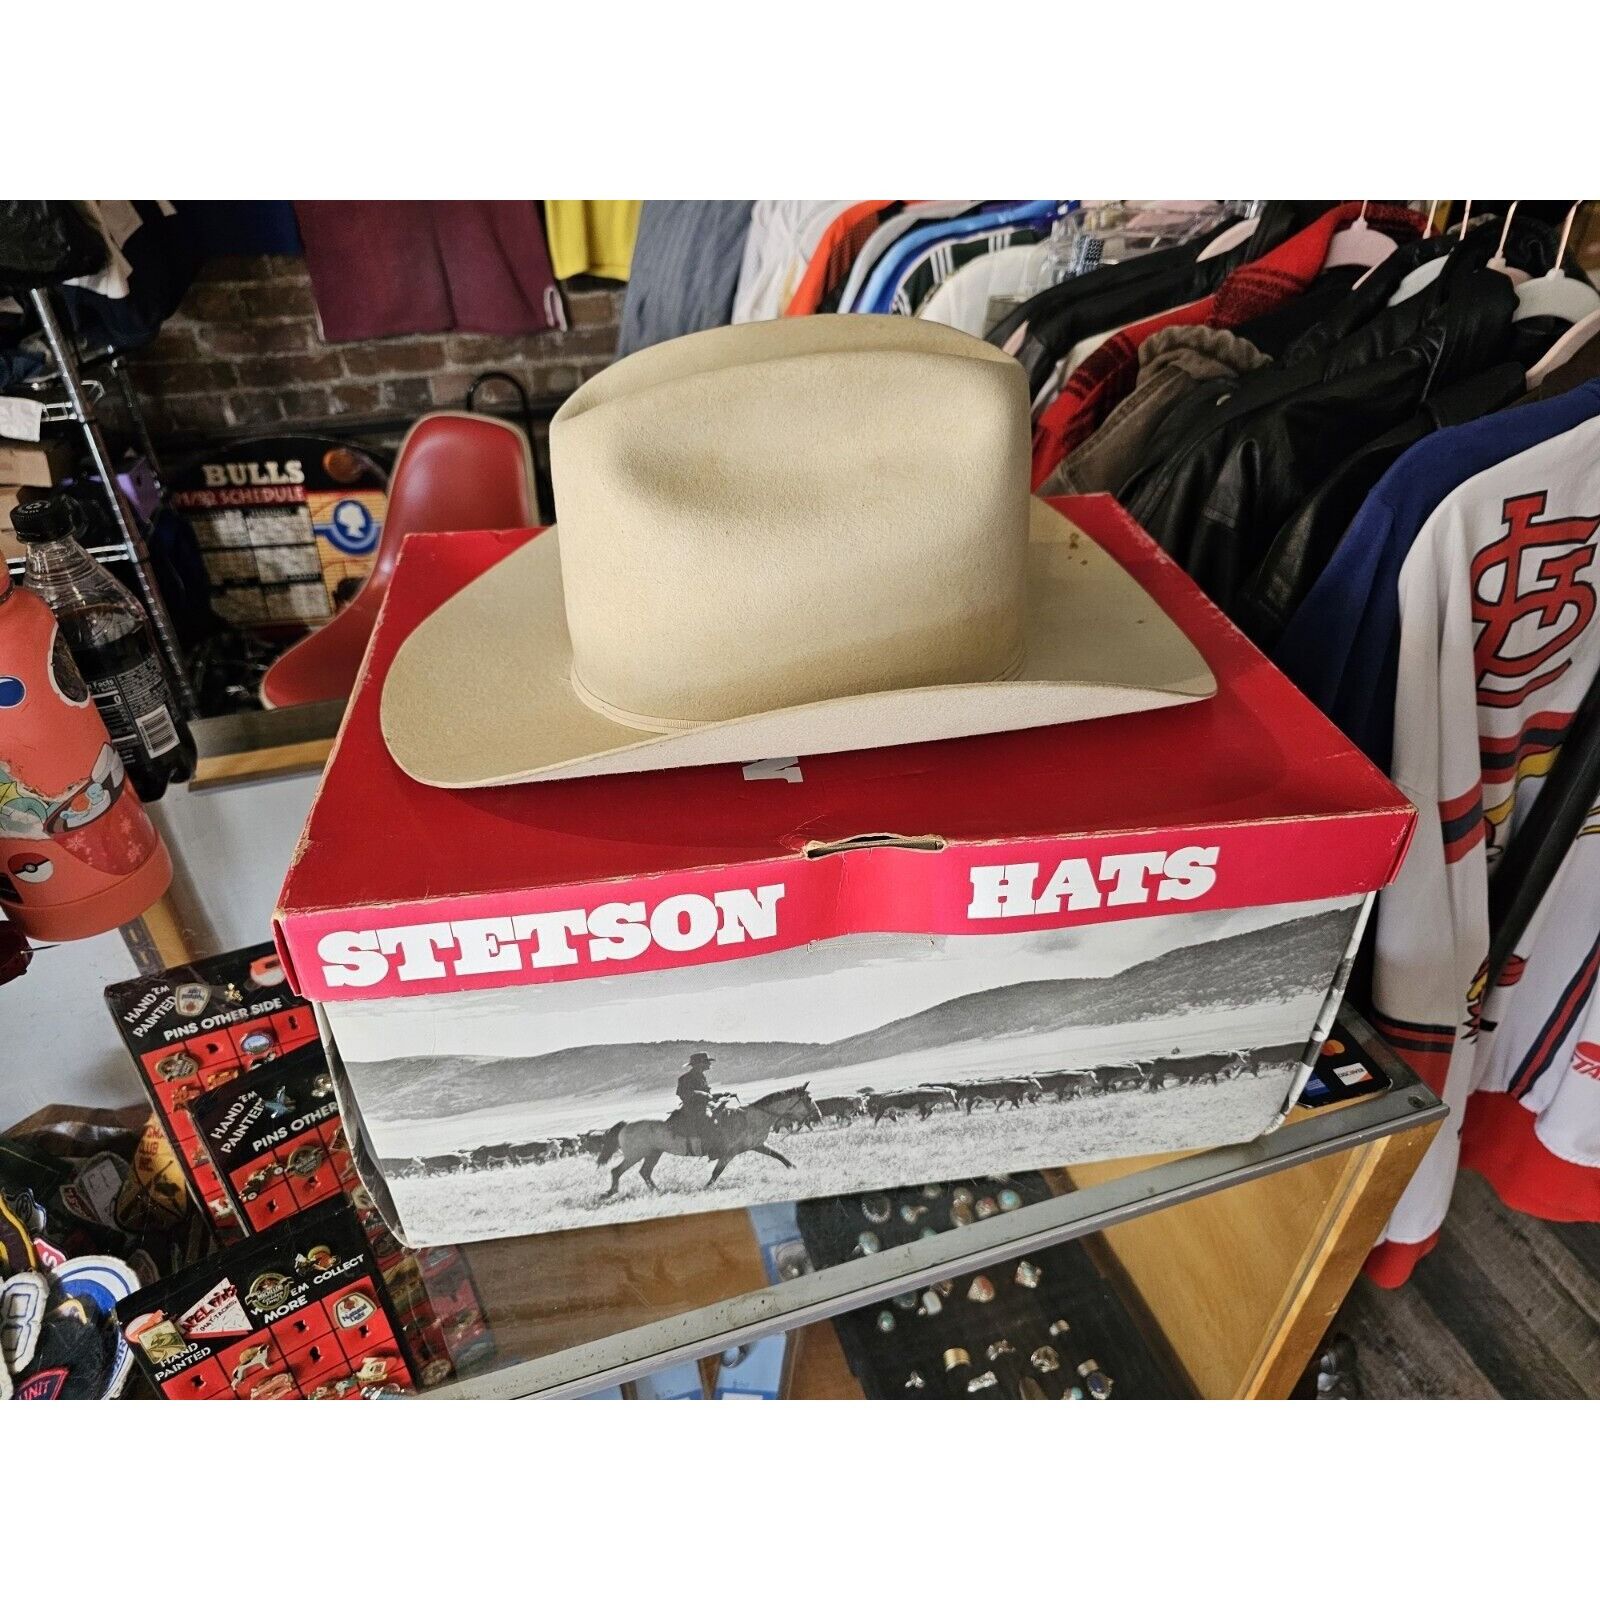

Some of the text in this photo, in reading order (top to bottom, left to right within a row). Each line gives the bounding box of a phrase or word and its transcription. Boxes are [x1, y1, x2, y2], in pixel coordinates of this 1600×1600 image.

[202, 460, 305, 487] BULLS
[967, 846, 1220, 919] HATS
[317, 883, 786, 987] STETSON
[124, 993, 157, 1023] HAND
[132, 995, 176, 1038] PAINTED
[163, 998, 283, 1041] PINS OTHER SIDE
[210, 1102, 244, 1139] HAND
[252, 1101, 340, 1152] PINS OTHER
[313, 1254, 364, 1284] COLLECT
[264, 1295, 308, 1324] MORE
[154, 1346, 212, 1382] PAINTED
[160, 1342, 199, 1368] HAND
